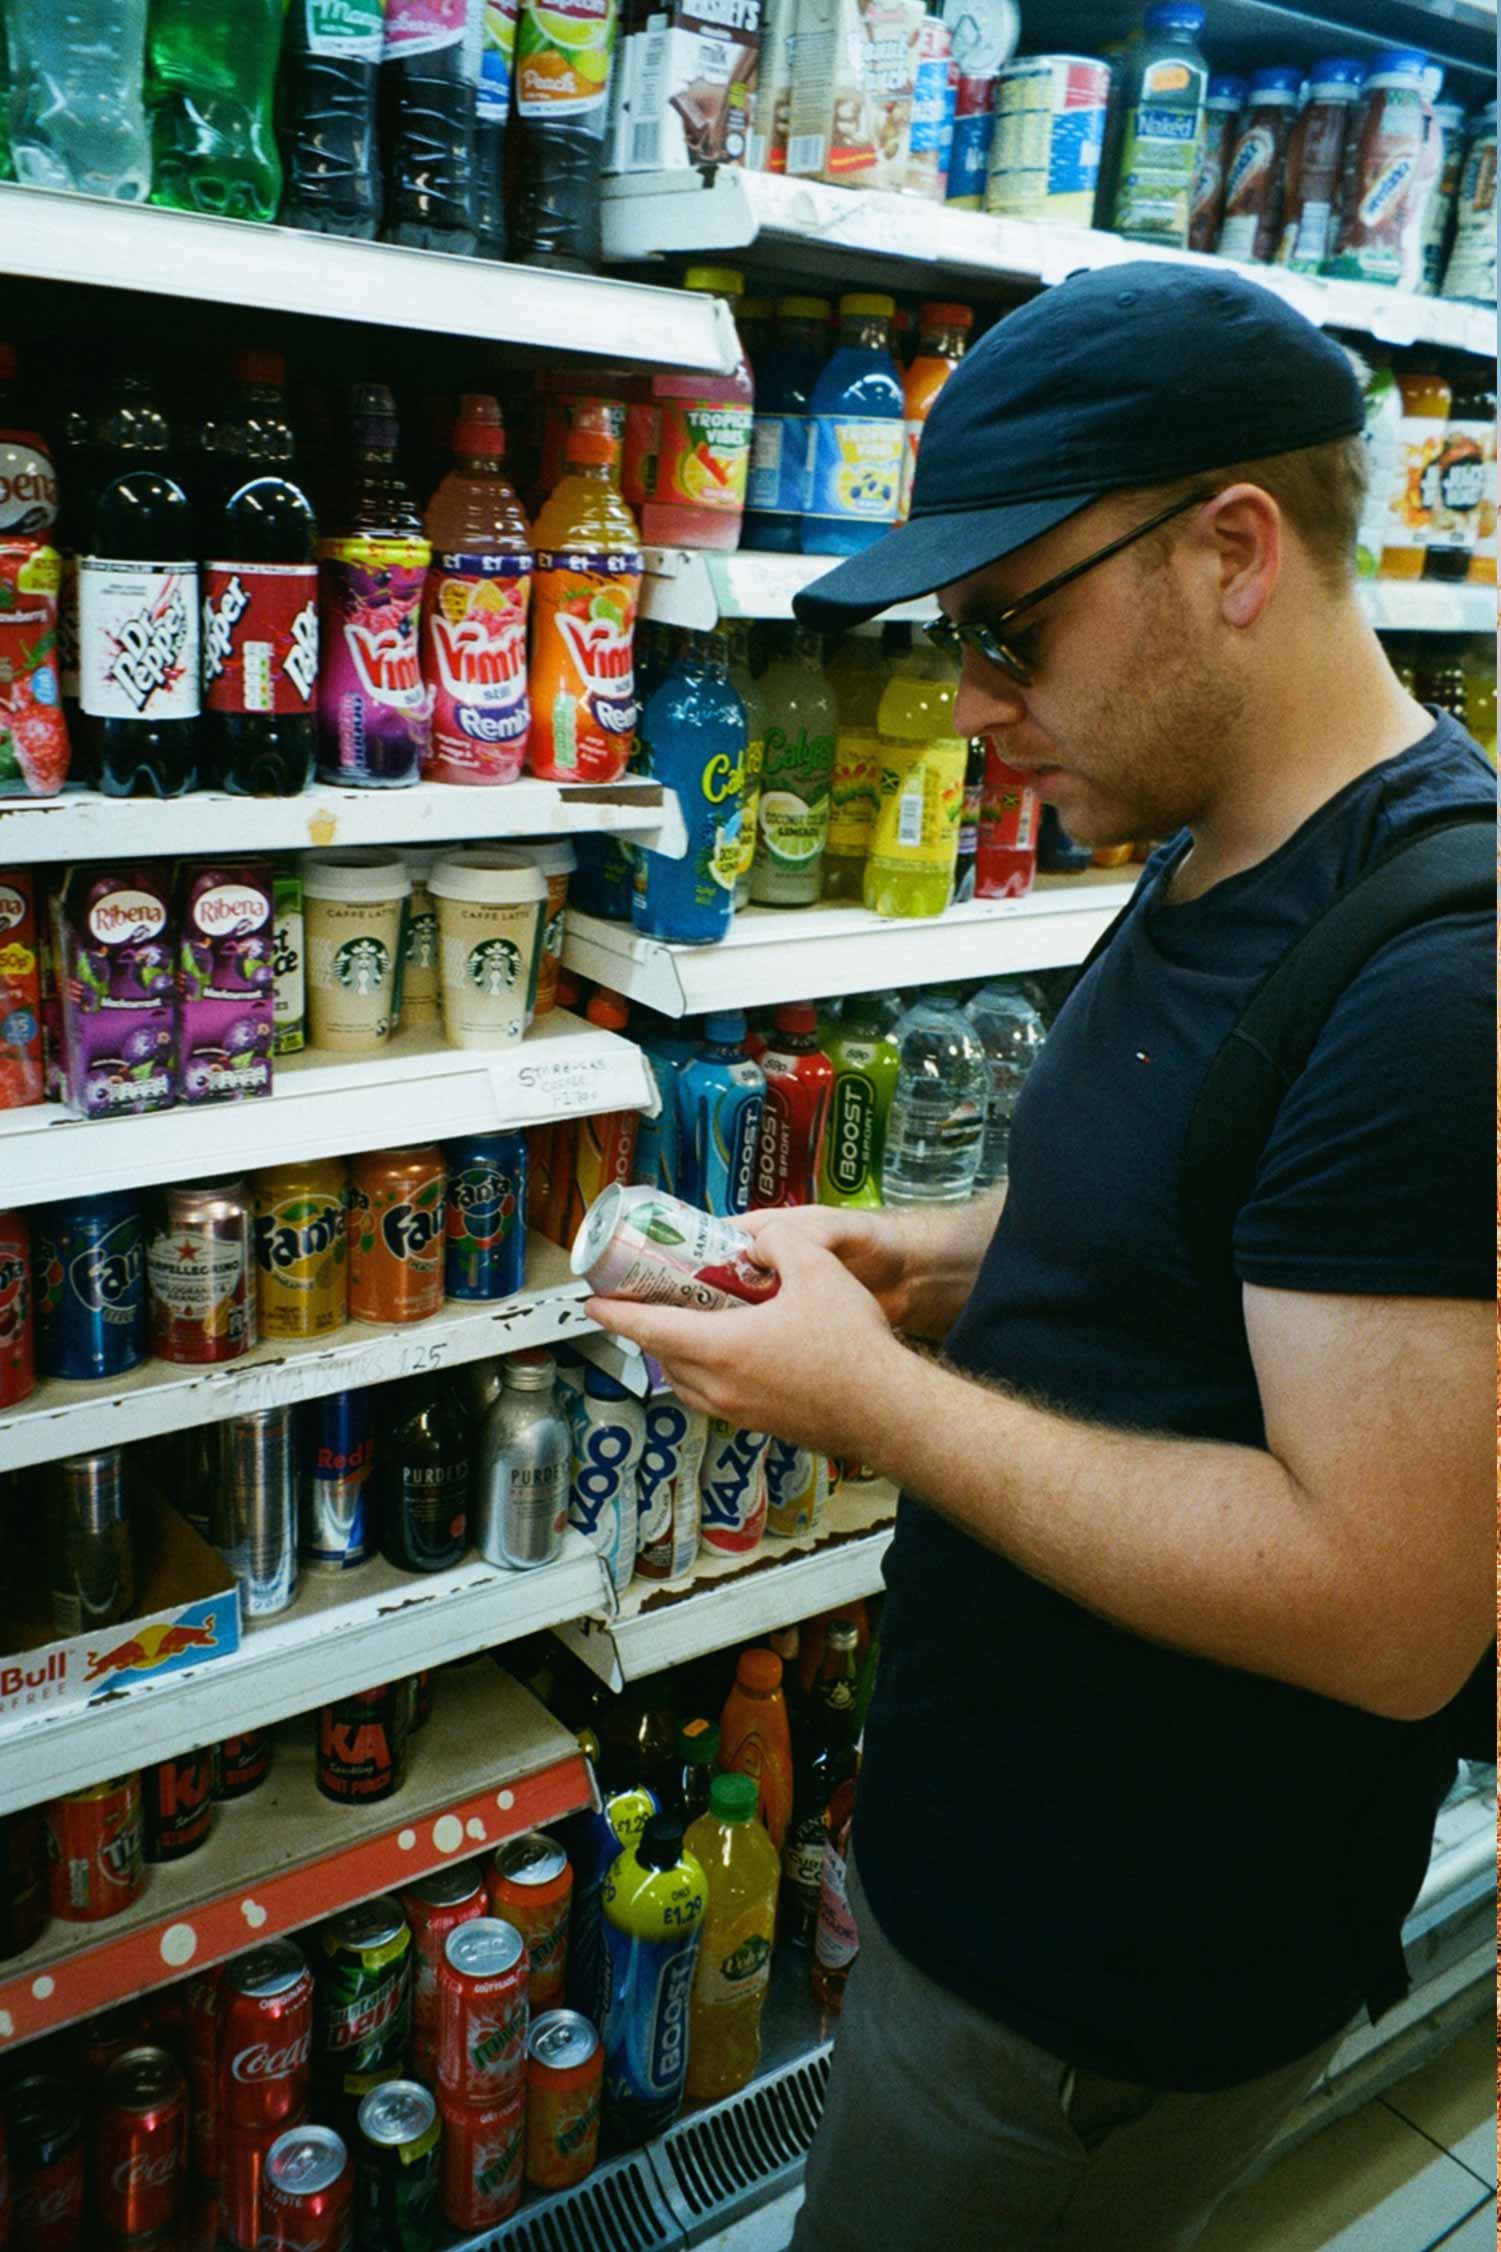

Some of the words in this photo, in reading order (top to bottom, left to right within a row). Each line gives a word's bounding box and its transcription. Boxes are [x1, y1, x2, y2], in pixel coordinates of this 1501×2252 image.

[95, 905, 162, 931] Ribena
[200, 898, 264, 924] Ribena
[736, 1106, 759, 1213] BOOST
[758, 1098, 781, 1196] BOOST
[780, 1122, 791, 1178] SPORT
[839, 1083, 865, 1182] BOOST
[863, 1108, 875, 1167] SPORT
[254, 1206, 347, 1273] Fanta
[1, 1650, 66, 1697] Bull
[321, 1706, 392, 1770] KA
[658, 1962, 691, 2079] BOOST
